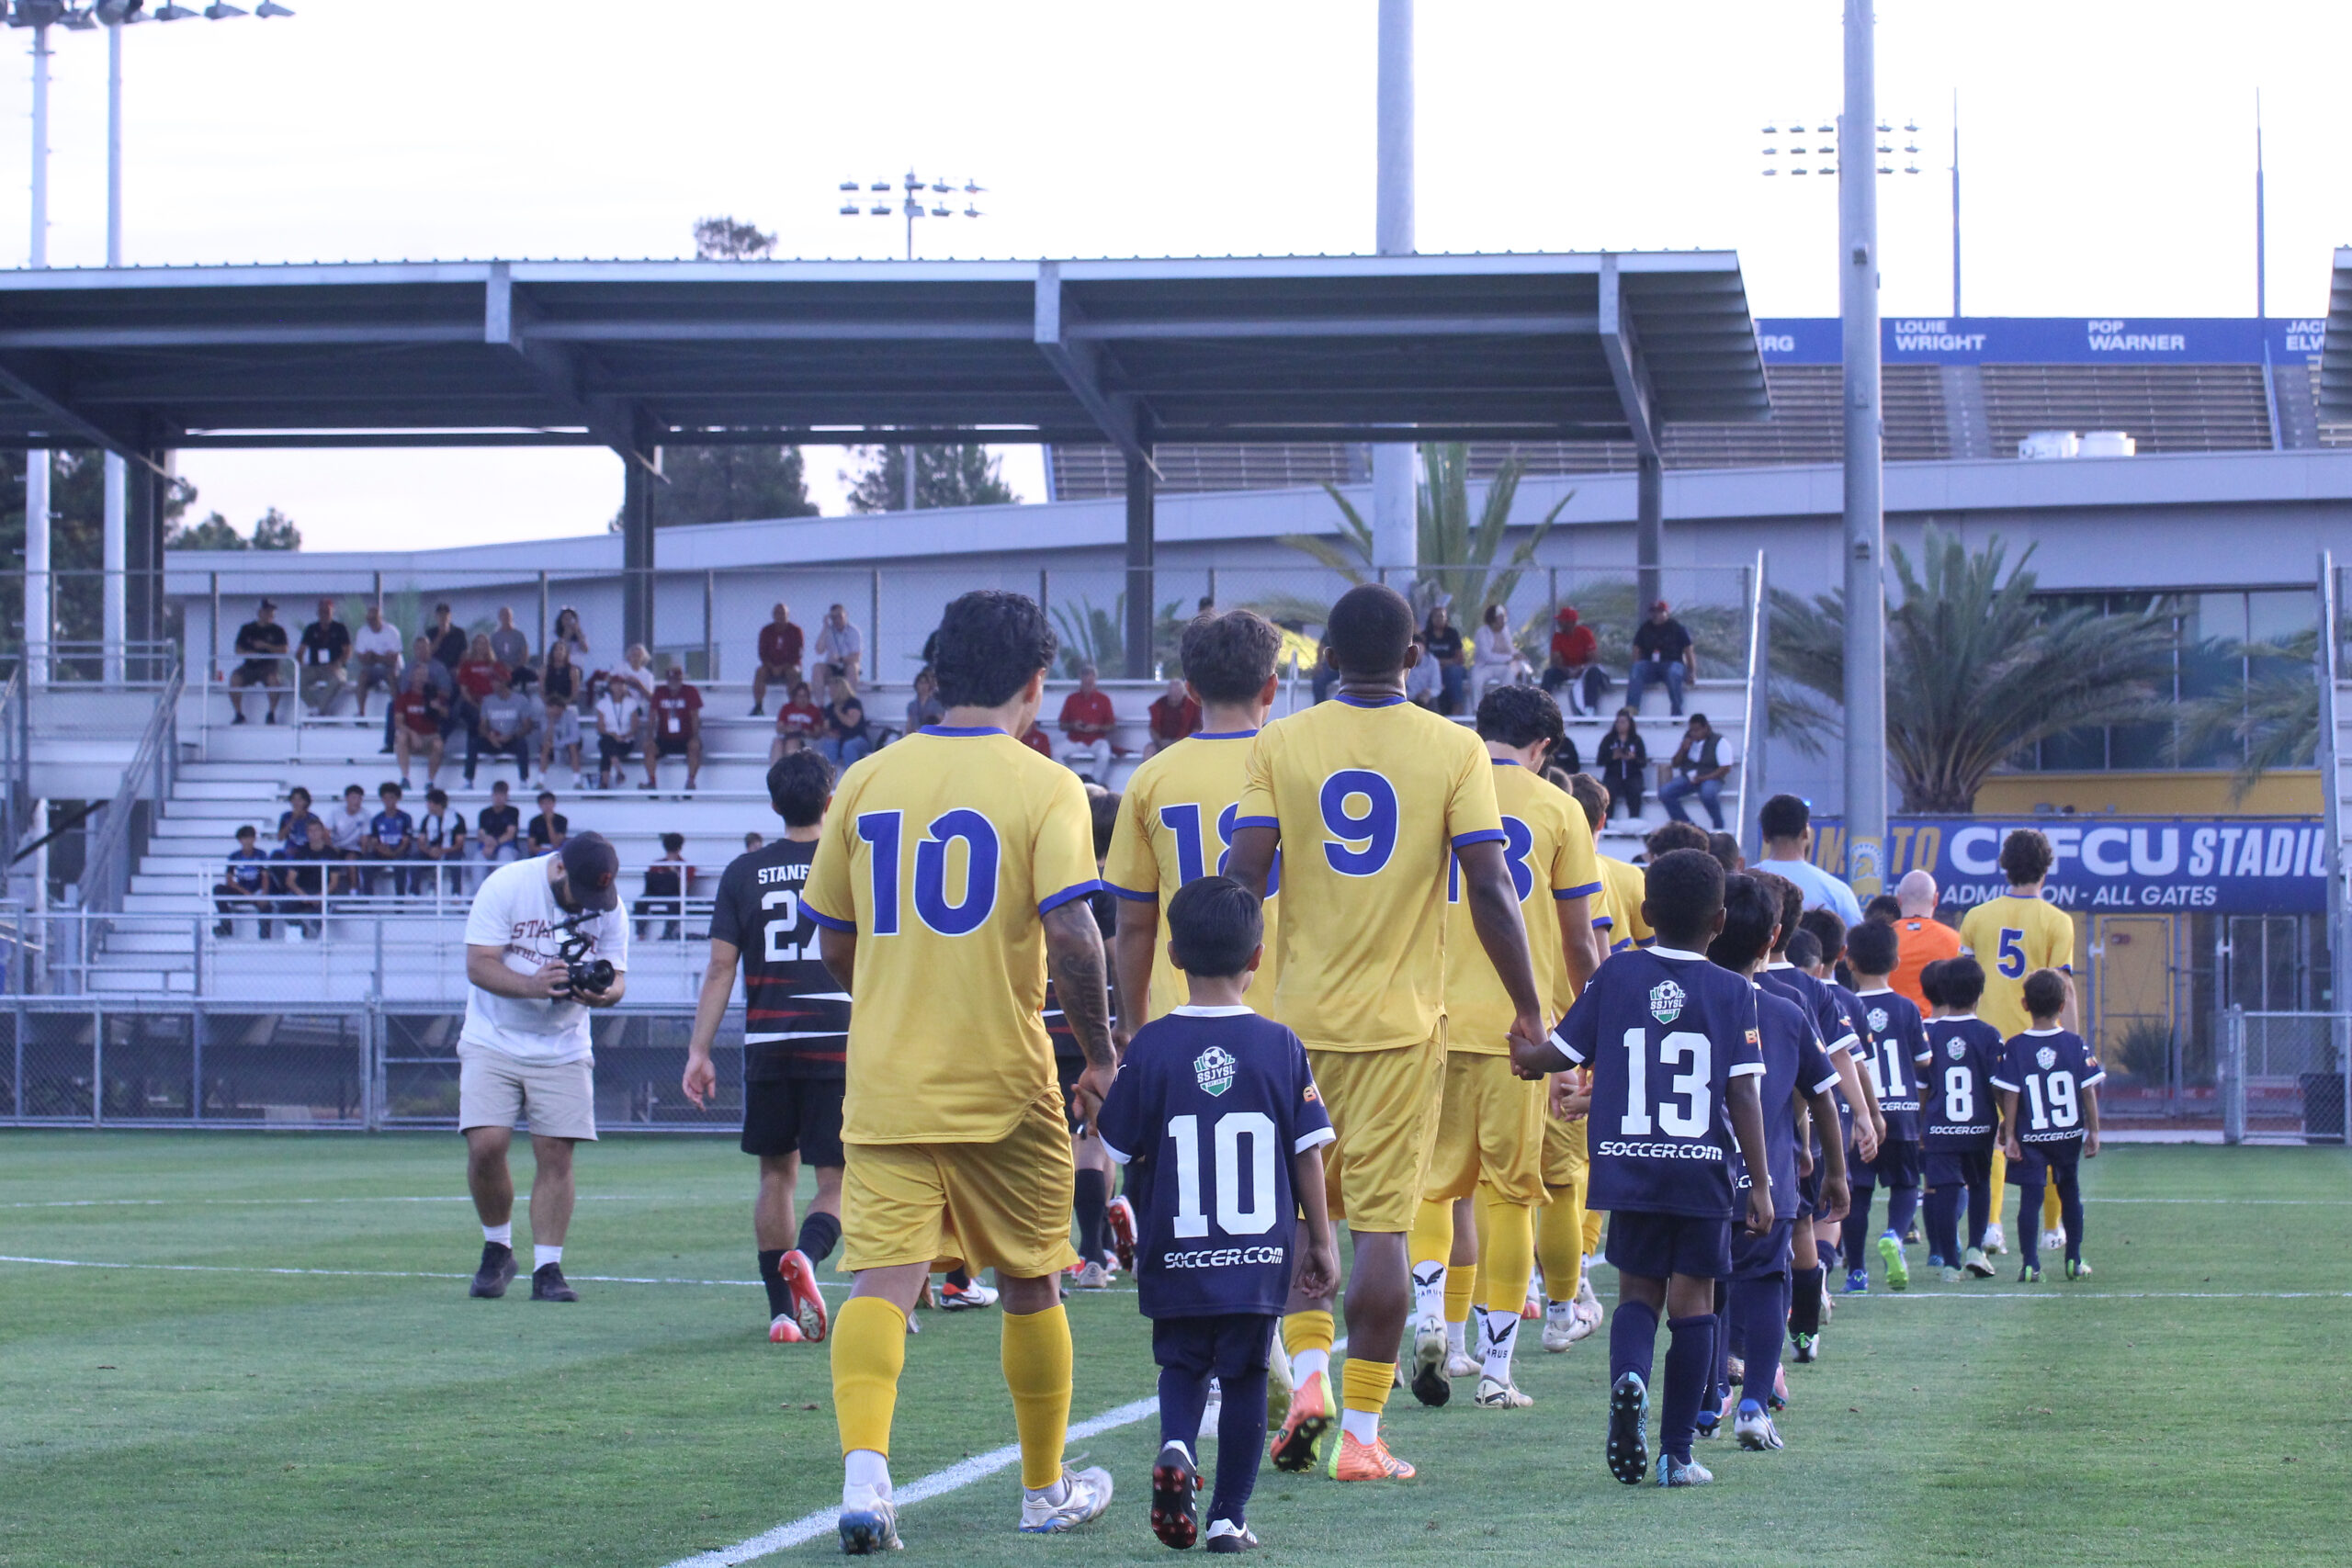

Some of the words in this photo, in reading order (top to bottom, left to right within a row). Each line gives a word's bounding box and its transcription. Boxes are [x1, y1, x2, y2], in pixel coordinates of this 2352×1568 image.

[1895, 321, 1947, 333] LOUIE
[2087, 321, 2124, 333] POP
[1895, 334, 1985, 351] WRIGHT
[2088, 335, 2185, 351] WARNER
[1318, 768, 1399, 877] 9
[1891, 827, 1940, 874] TO
[1950, 827, 2179, 876] CFCU
[856, 807, 1001, 937] 10
[1941, 885, 2075, 906] ADMION
[2092, 886, 2135, 906] ALL
[2141, 886, 2217, 906] GATES
[1996, 926, 2026, 980] 5
[1650, 998, 1683, 1010] SSJYSL
[1197, 1065, 1235, 1084] SSJYSL
[1621, 1028, 1712, 1138] 13
[1945, 1066, 1973, 1122] 8
[2025, 1070, 2079, 1130] 19
[1598, 1141, 1723, 1160] SOCCER.COM
[1168, 1112, 1276, 1238] 10
[1163, 1247, 1283, 1269] SOCCER.COM
